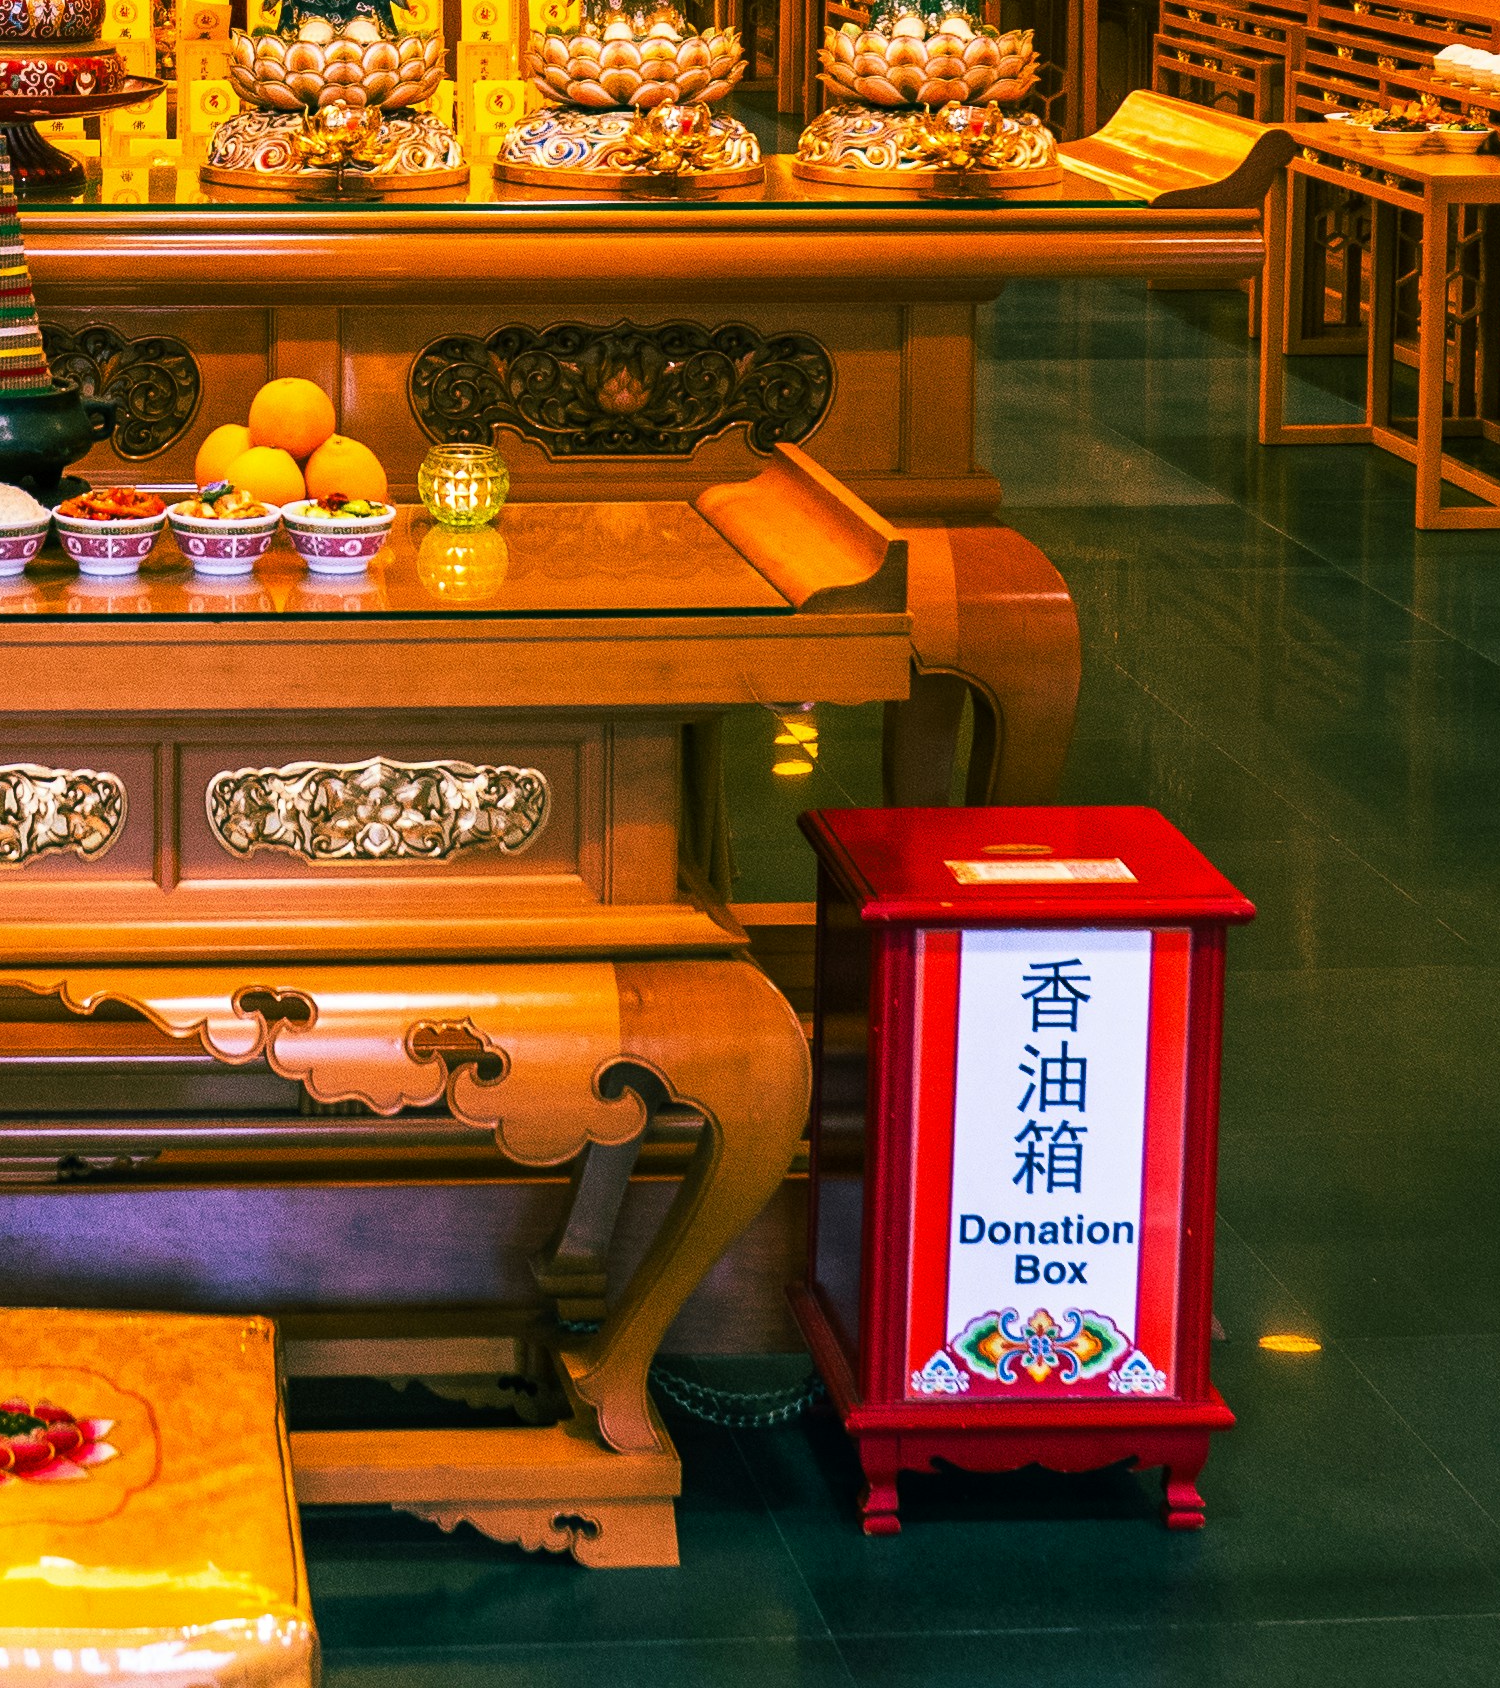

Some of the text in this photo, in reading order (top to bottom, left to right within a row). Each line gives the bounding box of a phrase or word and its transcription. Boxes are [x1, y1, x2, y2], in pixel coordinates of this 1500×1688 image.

[51, 122, 64, 132] 佛
[132, 120, 146, 130] 佛
[1012, 959, 1091, 1193] 香油箱
[959, 1215, 1133, 1245] Donation
[1014, 1254, 1088, 1285] Box
